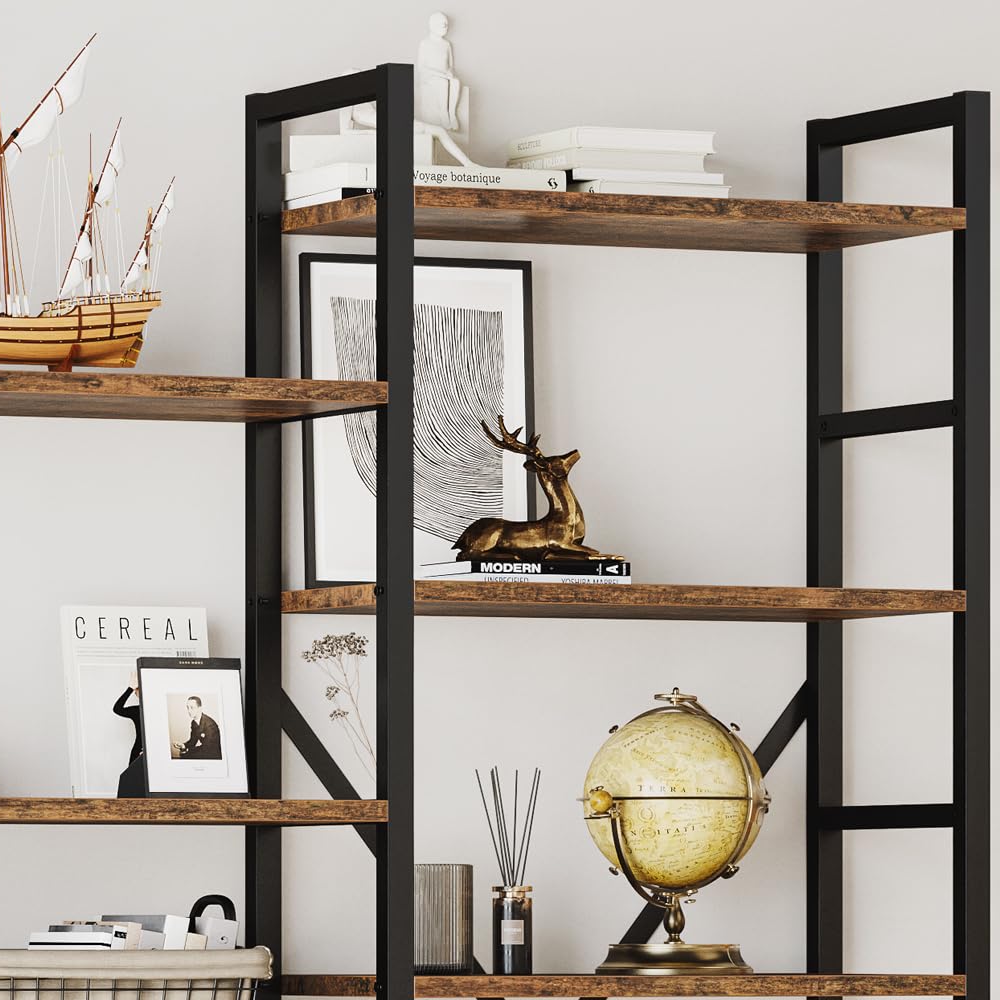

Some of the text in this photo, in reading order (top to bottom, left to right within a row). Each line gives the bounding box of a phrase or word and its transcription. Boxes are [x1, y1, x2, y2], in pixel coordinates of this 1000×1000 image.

[413, 171, 501, 186] Voyage botanique
[480, 562, 541, 574] MODERN
[75, 616, 198, 641] CEREAL
